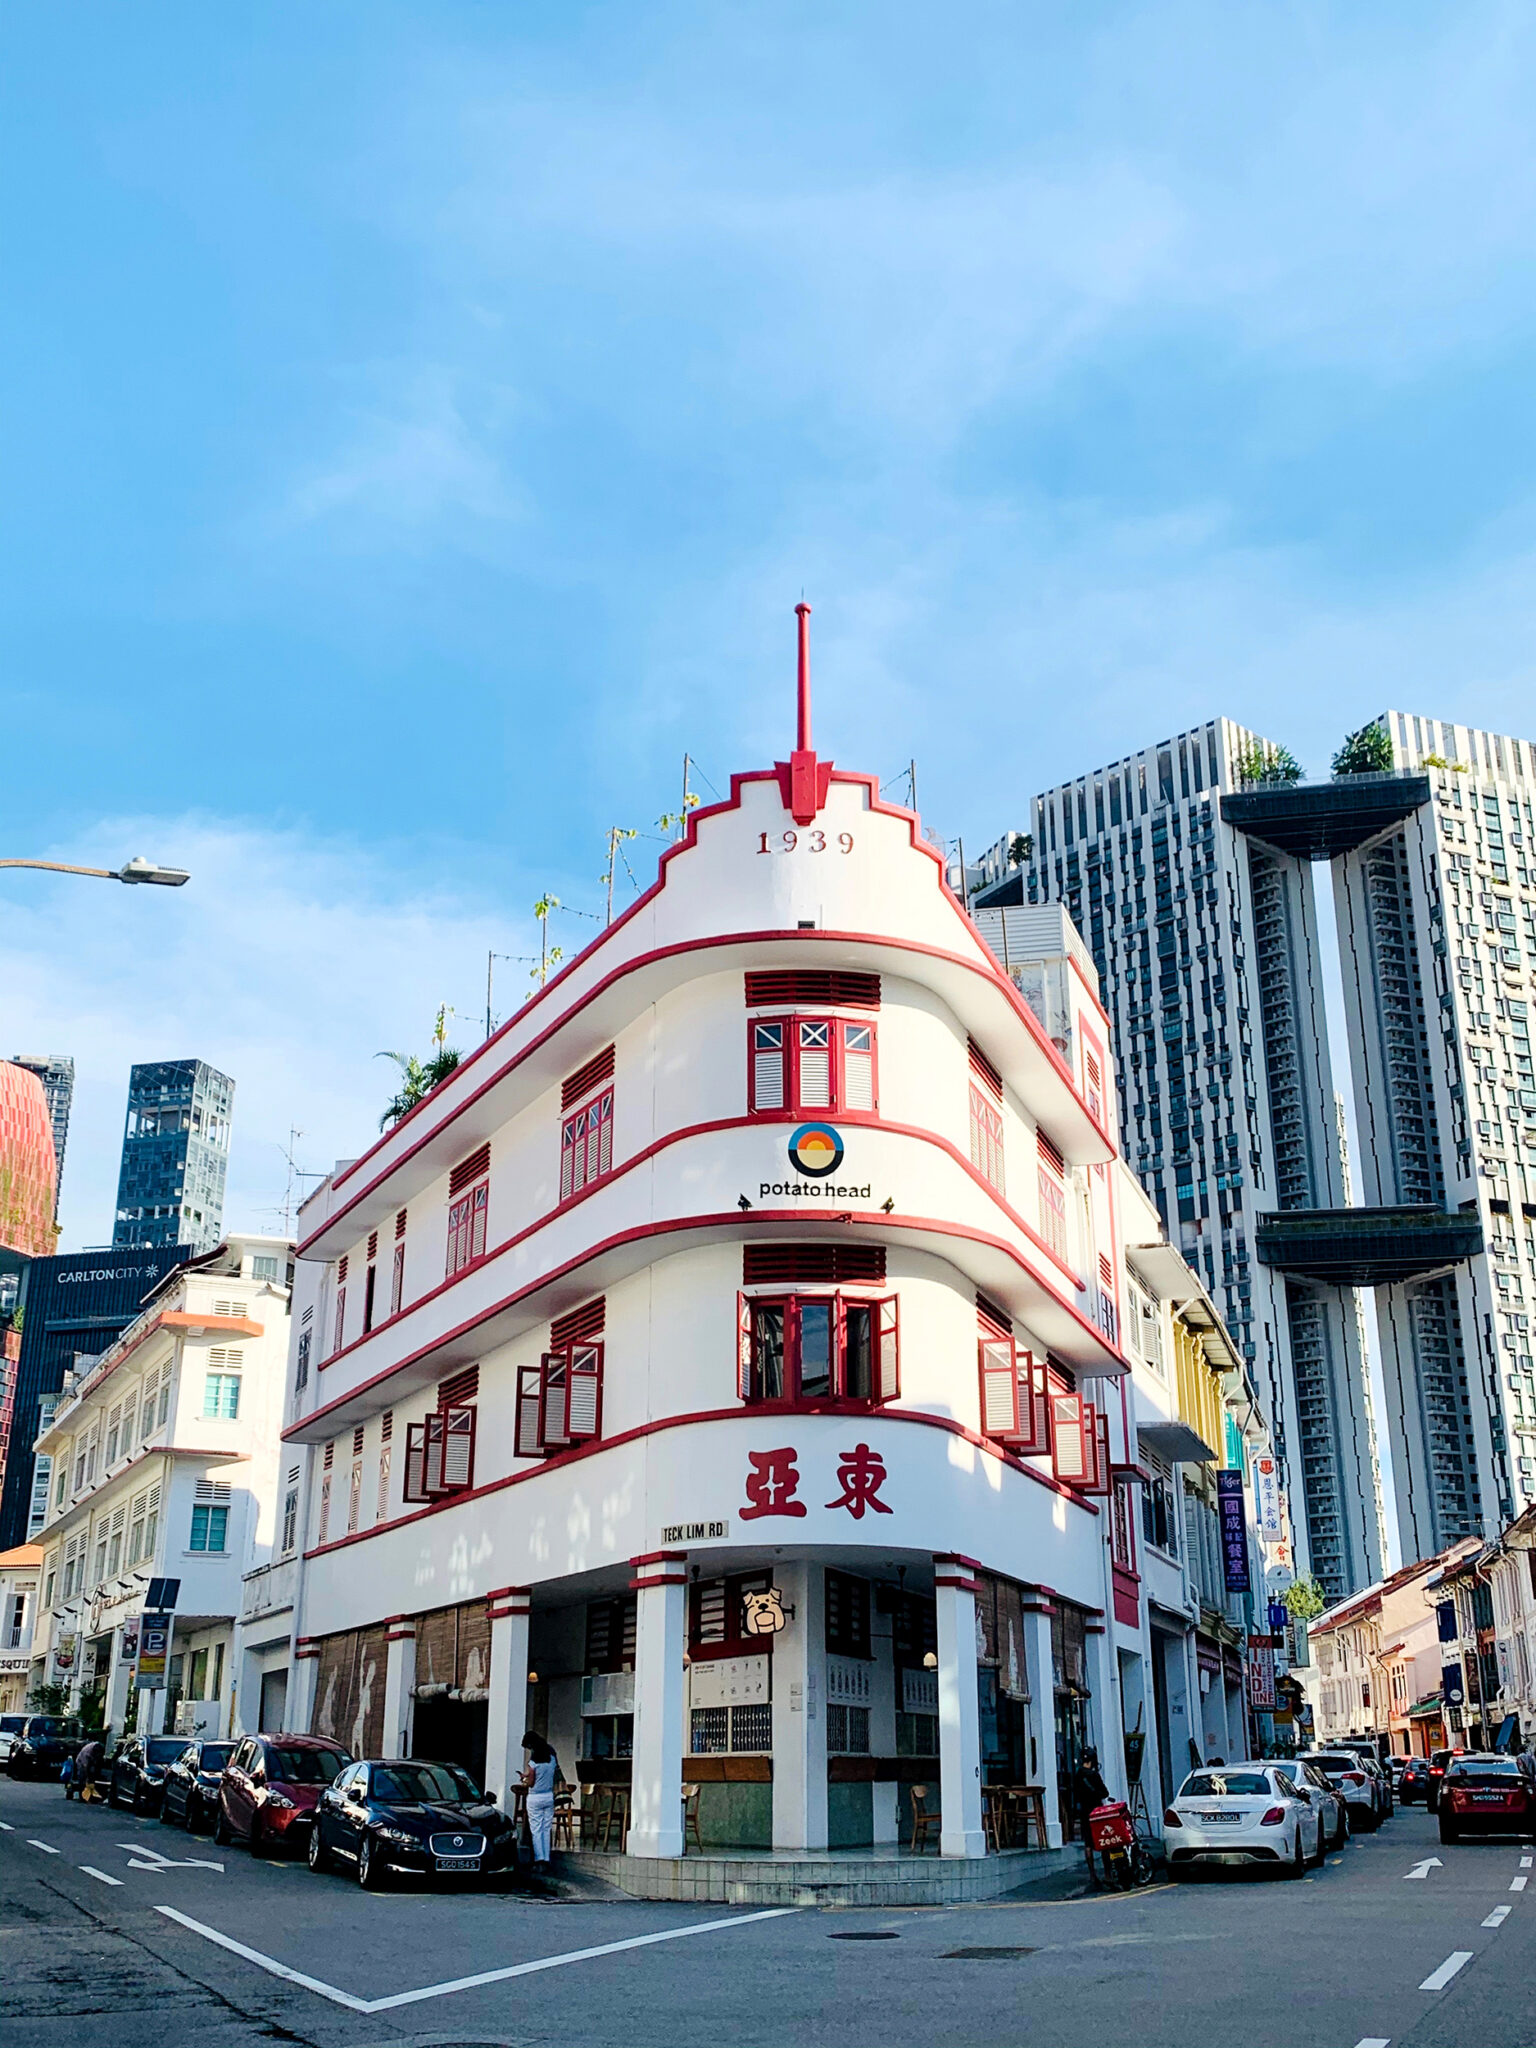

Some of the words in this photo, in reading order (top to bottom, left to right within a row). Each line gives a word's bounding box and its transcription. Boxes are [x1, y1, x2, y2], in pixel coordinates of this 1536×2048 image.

[756, 830, 854, 854] 1939
[760, 1181, 821, 1199] potato
[825, 1182, 871, 1198] head
[1219, 1476, 1241, 1489] Tiger
[664, 1526, 683, 1543] TECK
[687, 1524, 704, 1539] LIM
[709, 1522, 723, 1537] RD
